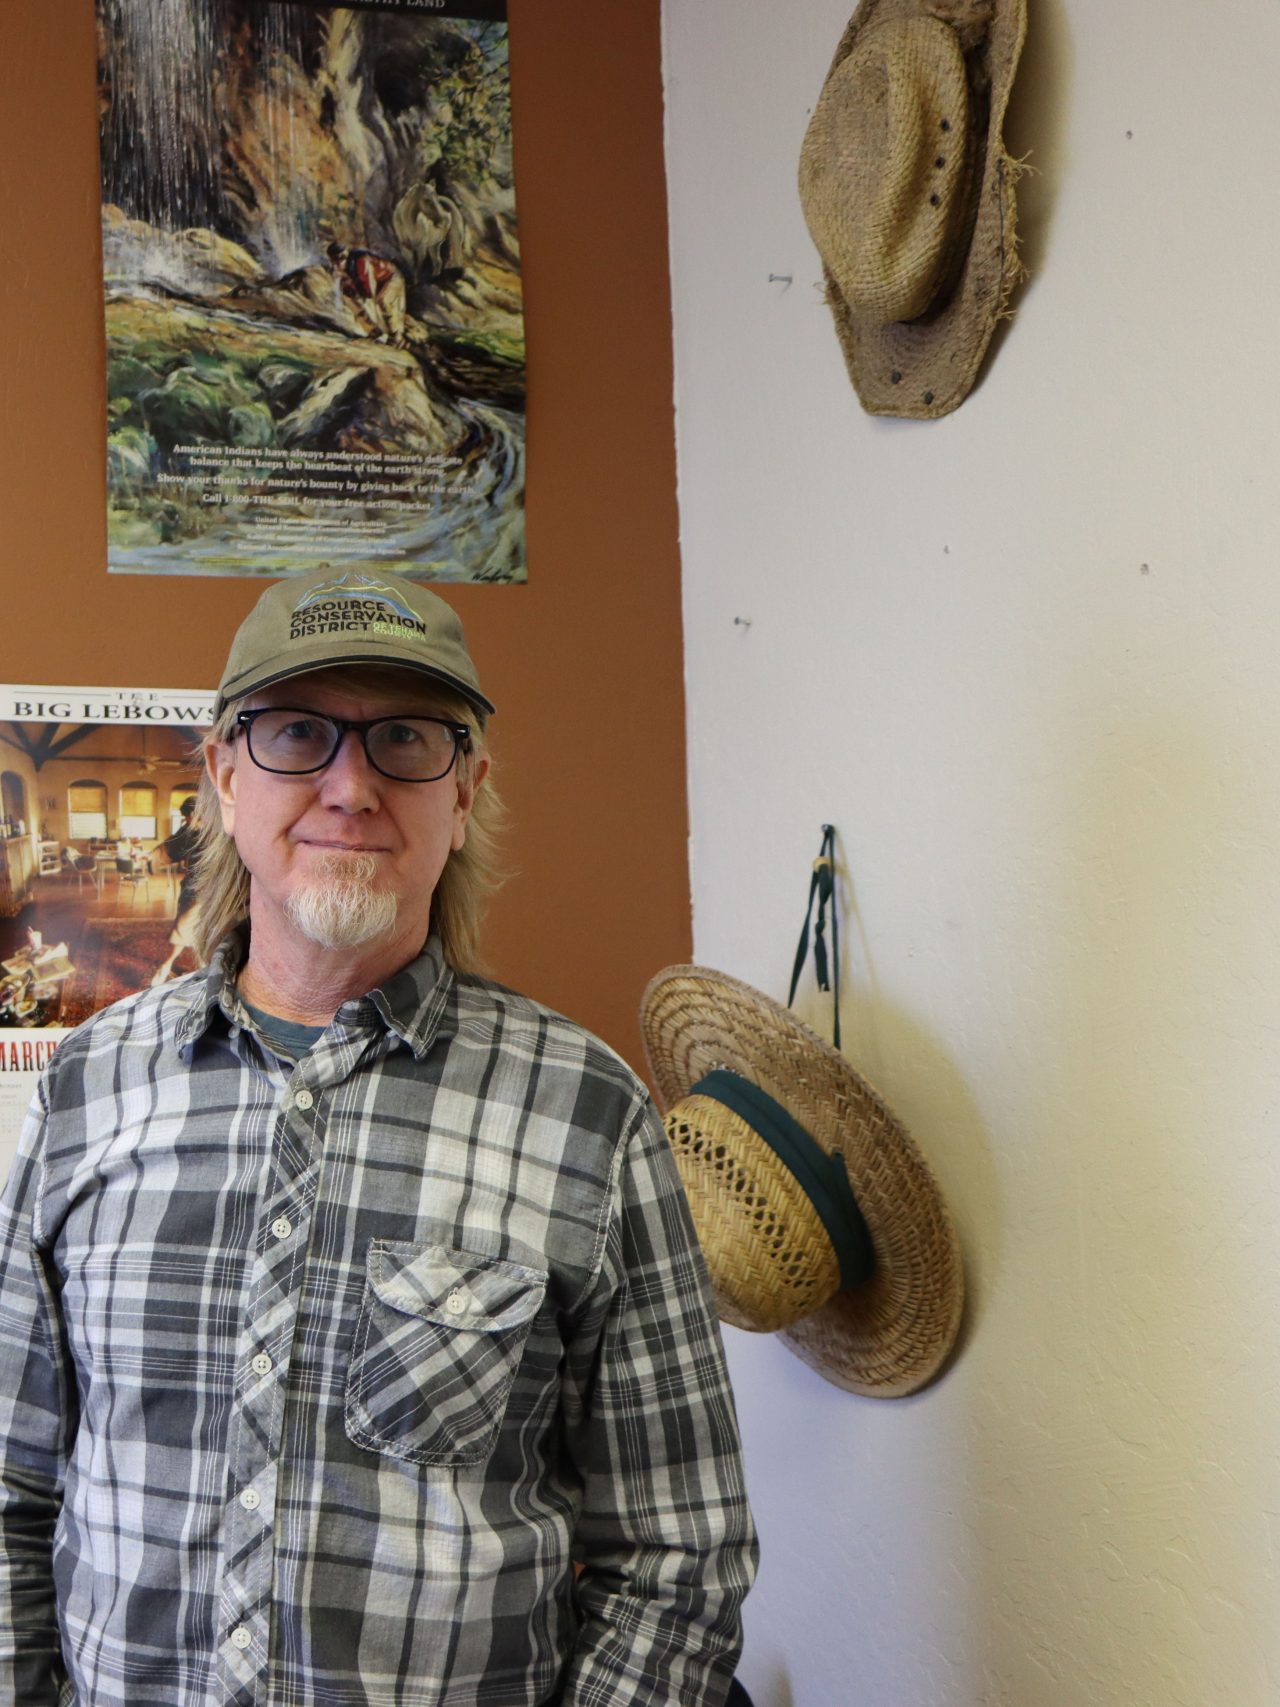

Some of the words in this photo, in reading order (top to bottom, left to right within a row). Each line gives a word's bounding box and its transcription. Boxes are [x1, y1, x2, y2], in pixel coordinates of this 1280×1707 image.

[172, 444, 222, 455] American
[224, 446, 263, 456] Indians
[264, 446, 288, 458] have
[290, 448, 324, 461] always
[326, 450, 382, 462] understood
[384, 454, 423, 463] nature's
[190, 456, 230, 466] balance
[232, 458, 252, 468] that
[255, 458, 284, 470] keeps
[286, 459, 302, 470] the
[304, 460, 352, 472] heartbeat
[354, 464, 364, 474] of
[366, 464, 383, 474] the
[384, 465, 412, 475] earth
[156, 472, 184, 484] Show
[186, 475, 210, 486] your
[213, 475, 248, 486] thanks
[250, 476, 264, 486] for
[268, 478, 308, 488] nature's
[310, 479, 344, 492] bounty
[346, 480, 358, 492] by
[360, 482, 391, 494] giving
[392, 482, 416, 492] back
[417, 484, 428, 493] to
[430, 484, 446, 494] the
[202, 493, 221, 503] Call
[302, 496, 318, 506] for
[320, 500, 342, 510] your
[366, 500, 398, 510] action
[291, 599, 386, 620] RESOURCE
[290, 610, 426, 635] CONSERVATION
[290, 621, 372, 640] DISTRICT
[14, 702, 72, 718] BIG
